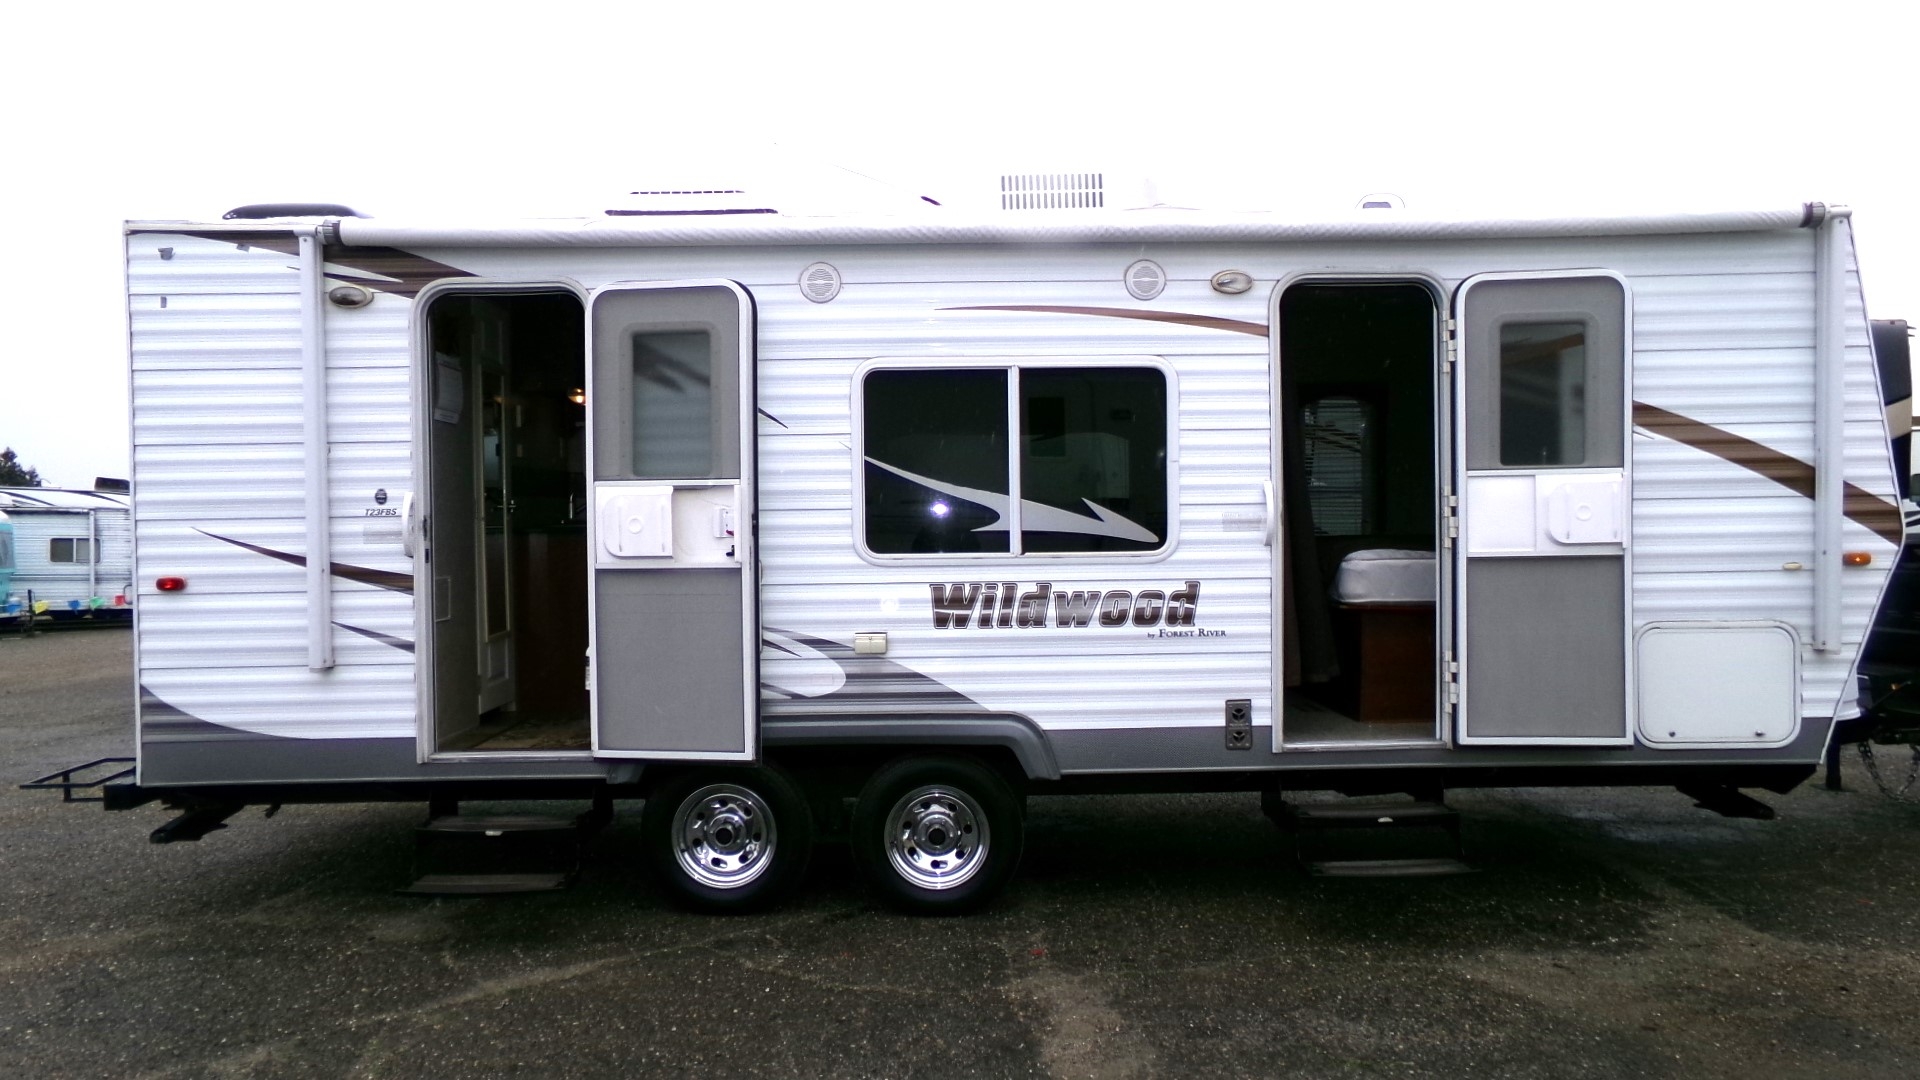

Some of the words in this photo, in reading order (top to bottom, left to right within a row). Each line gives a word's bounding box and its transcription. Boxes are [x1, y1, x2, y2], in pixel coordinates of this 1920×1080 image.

[365, 508, 397, 517] T23FBS
[929, 581, 1201, 629] Wildwood
[1159, 628, 1195, 638] FOREST
[1197, 628, 1227, 637] RIVER
